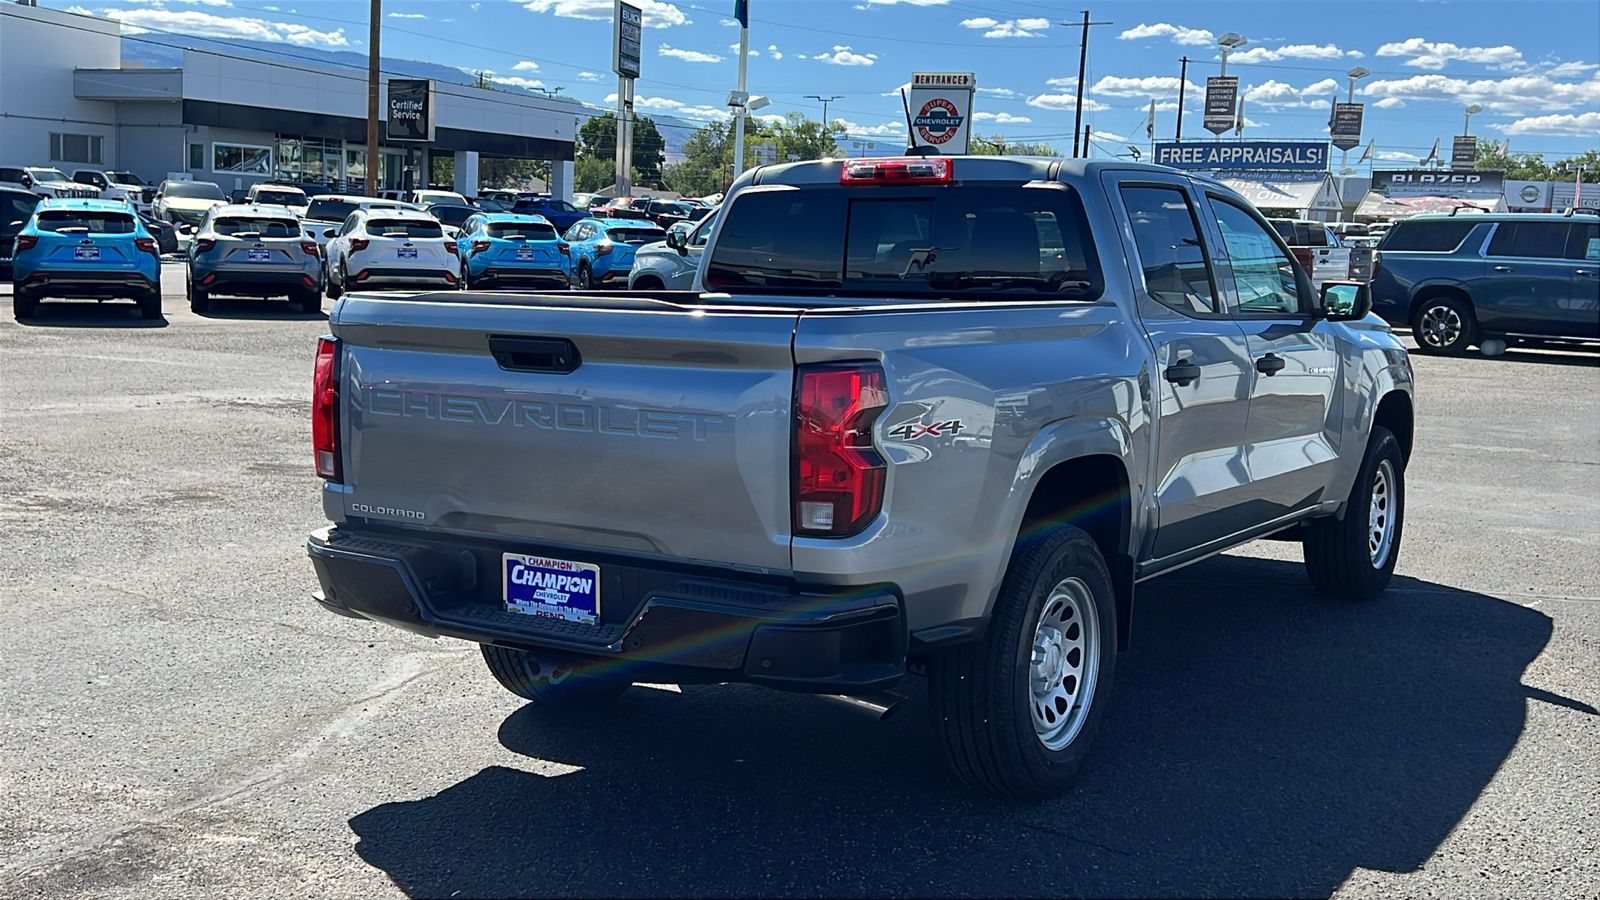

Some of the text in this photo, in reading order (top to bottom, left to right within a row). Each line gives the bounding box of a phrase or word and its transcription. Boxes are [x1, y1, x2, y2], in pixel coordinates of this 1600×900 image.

[920, 75, 963, 85] ENTRANCE
[391, 99, 423, 110] Certified
[924, 99, 953, 111] SUPER
[392, 109, 420, 120] Service
[920, 129, 955, 143] SERVICE
[1160, 147, 1323, 164] FREE APPRAISALS!
[1240, 172, 1270, 180] Kelley
[1391, 174, 1481, 187] BLAZER
[1564, 198, 1600, 207] Uited
[369, 388, 724, 442] CHEVROLET
[352, 503, 426, 520] COLORADO
[527, 557, 573, 571] CHAMPION
[511, 565, 593, 595] CHAMPION
[535, 590, 567, 601] CHEVROLET
